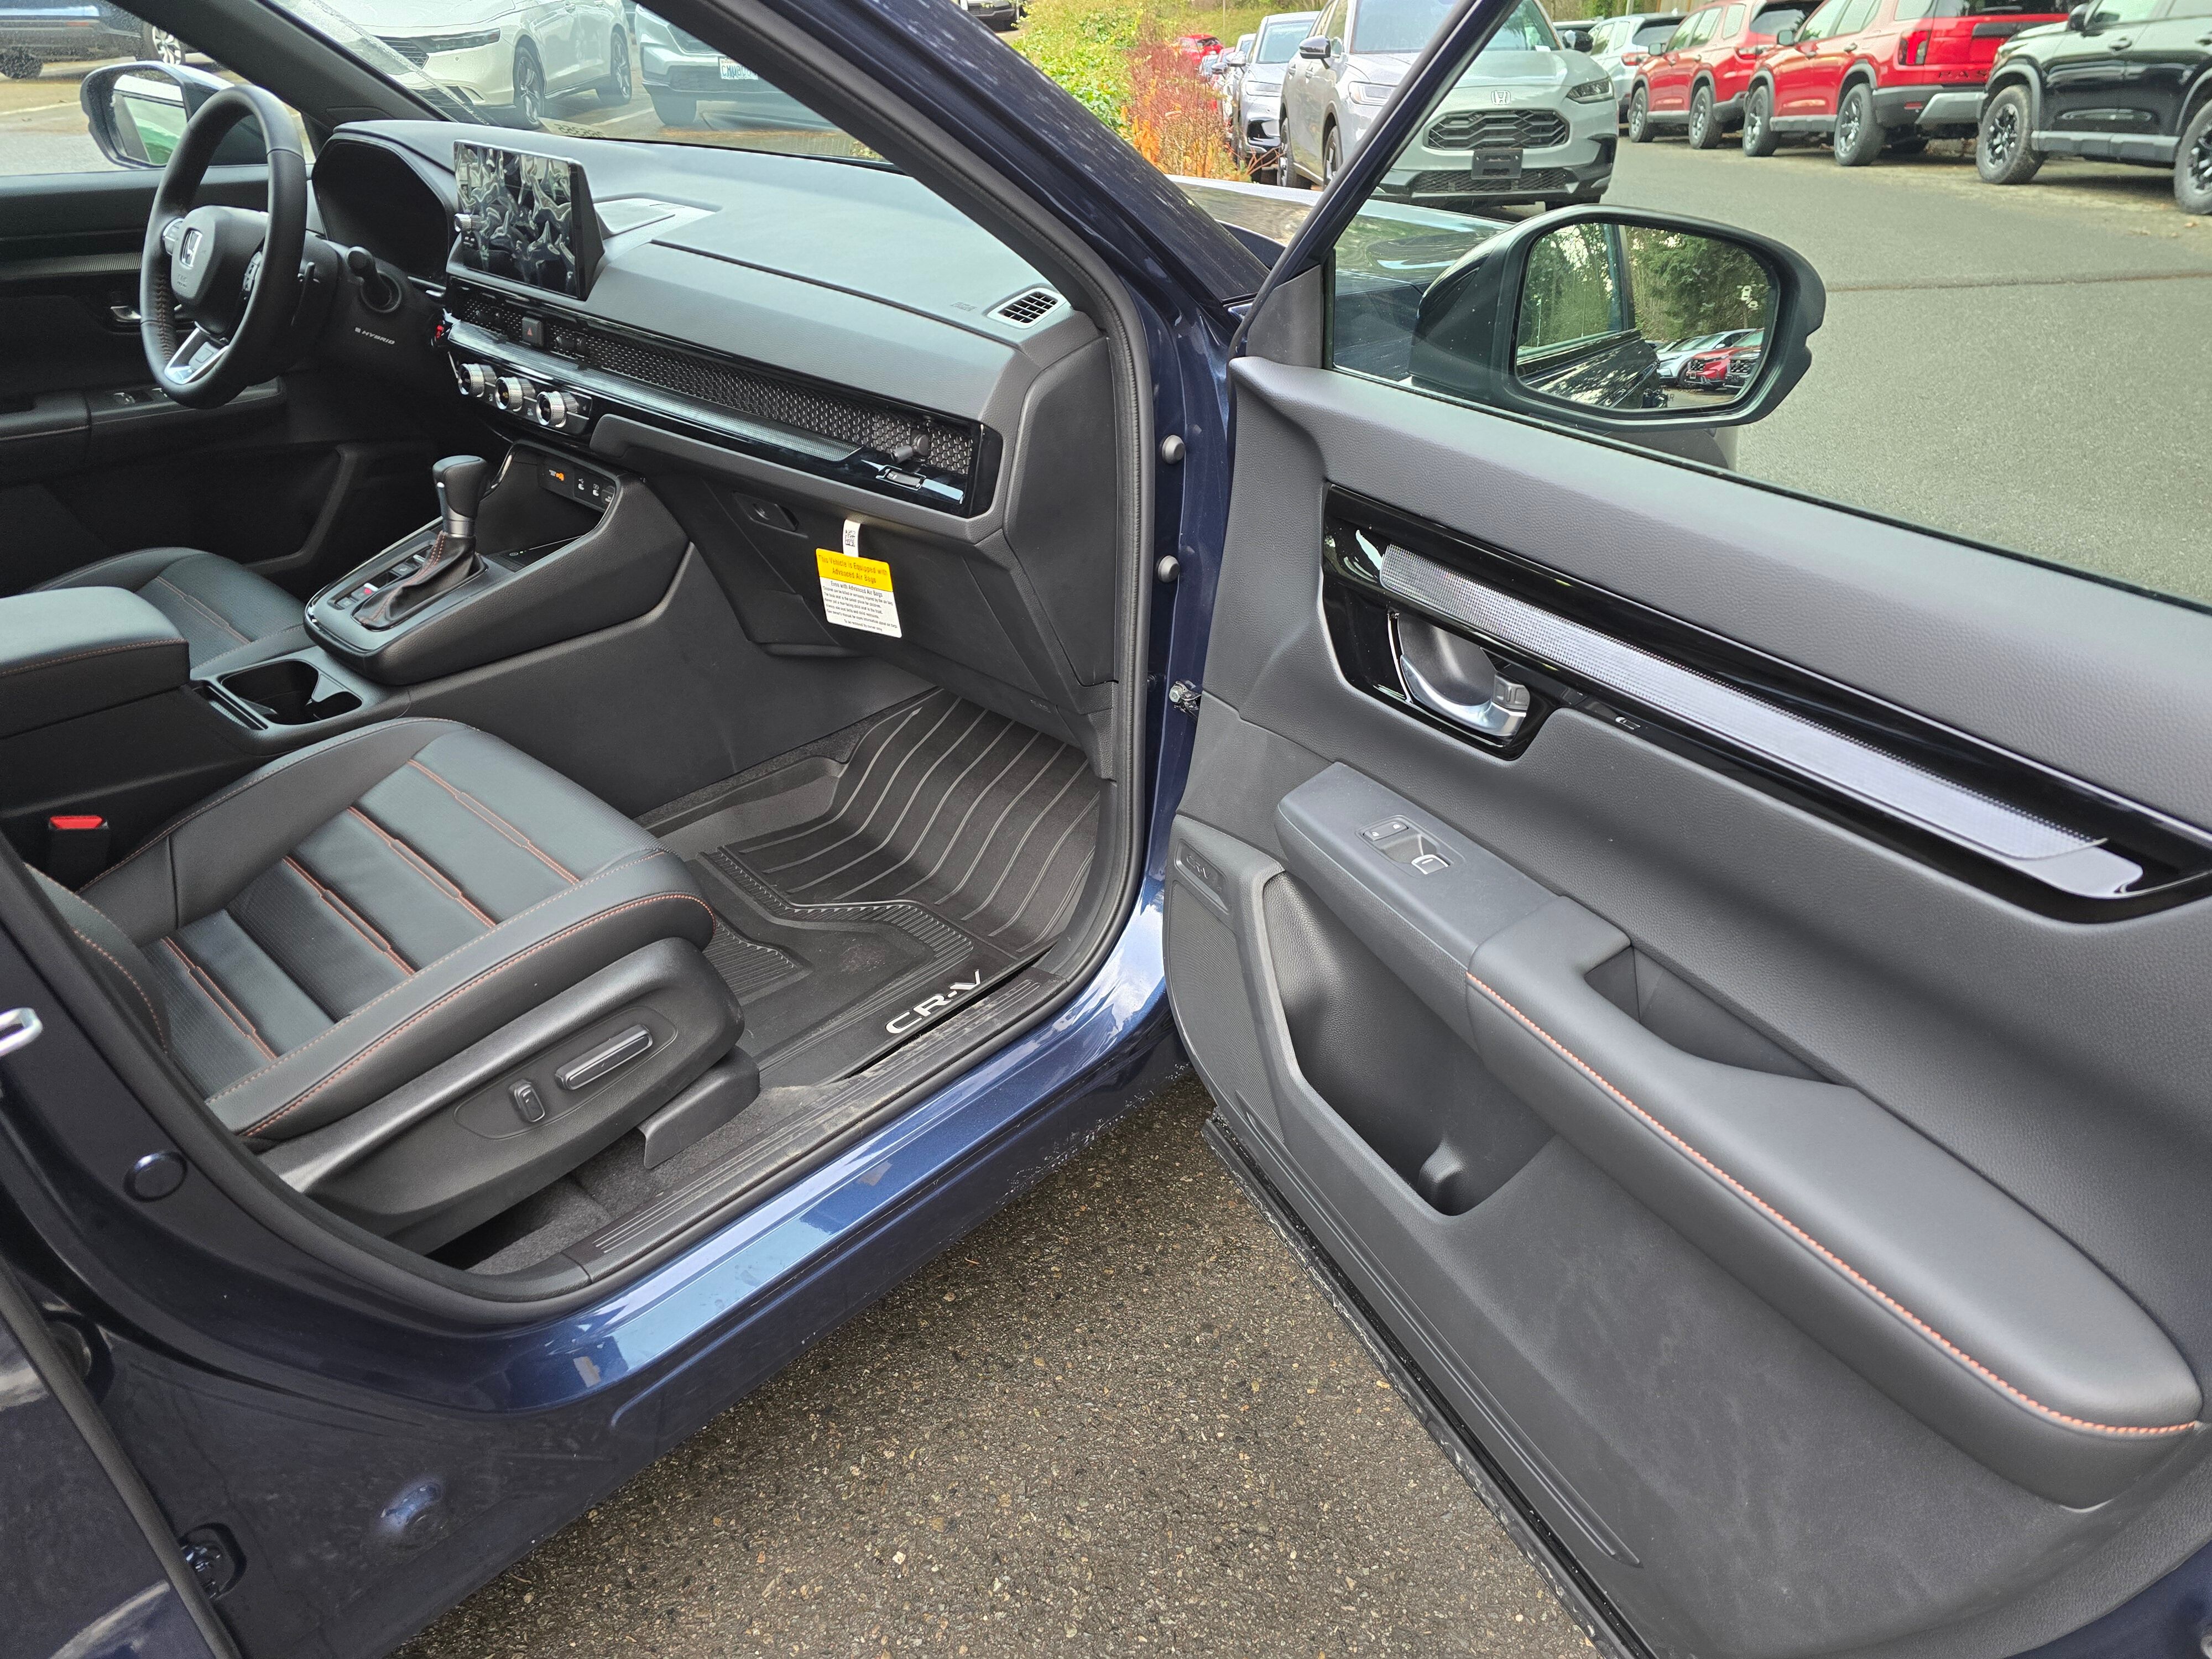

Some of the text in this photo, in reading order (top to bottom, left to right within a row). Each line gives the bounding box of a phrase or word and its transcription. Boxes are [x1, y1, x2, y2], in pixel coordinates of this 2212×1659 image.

[830, 557, 847, 567] Vehicle
[853, 562, 876, 574] Equipped
[832, 567, 854, 578] Advanced
[864, 575, 877, 584] Bags
[886, 969, 980, 1034] CR-V
